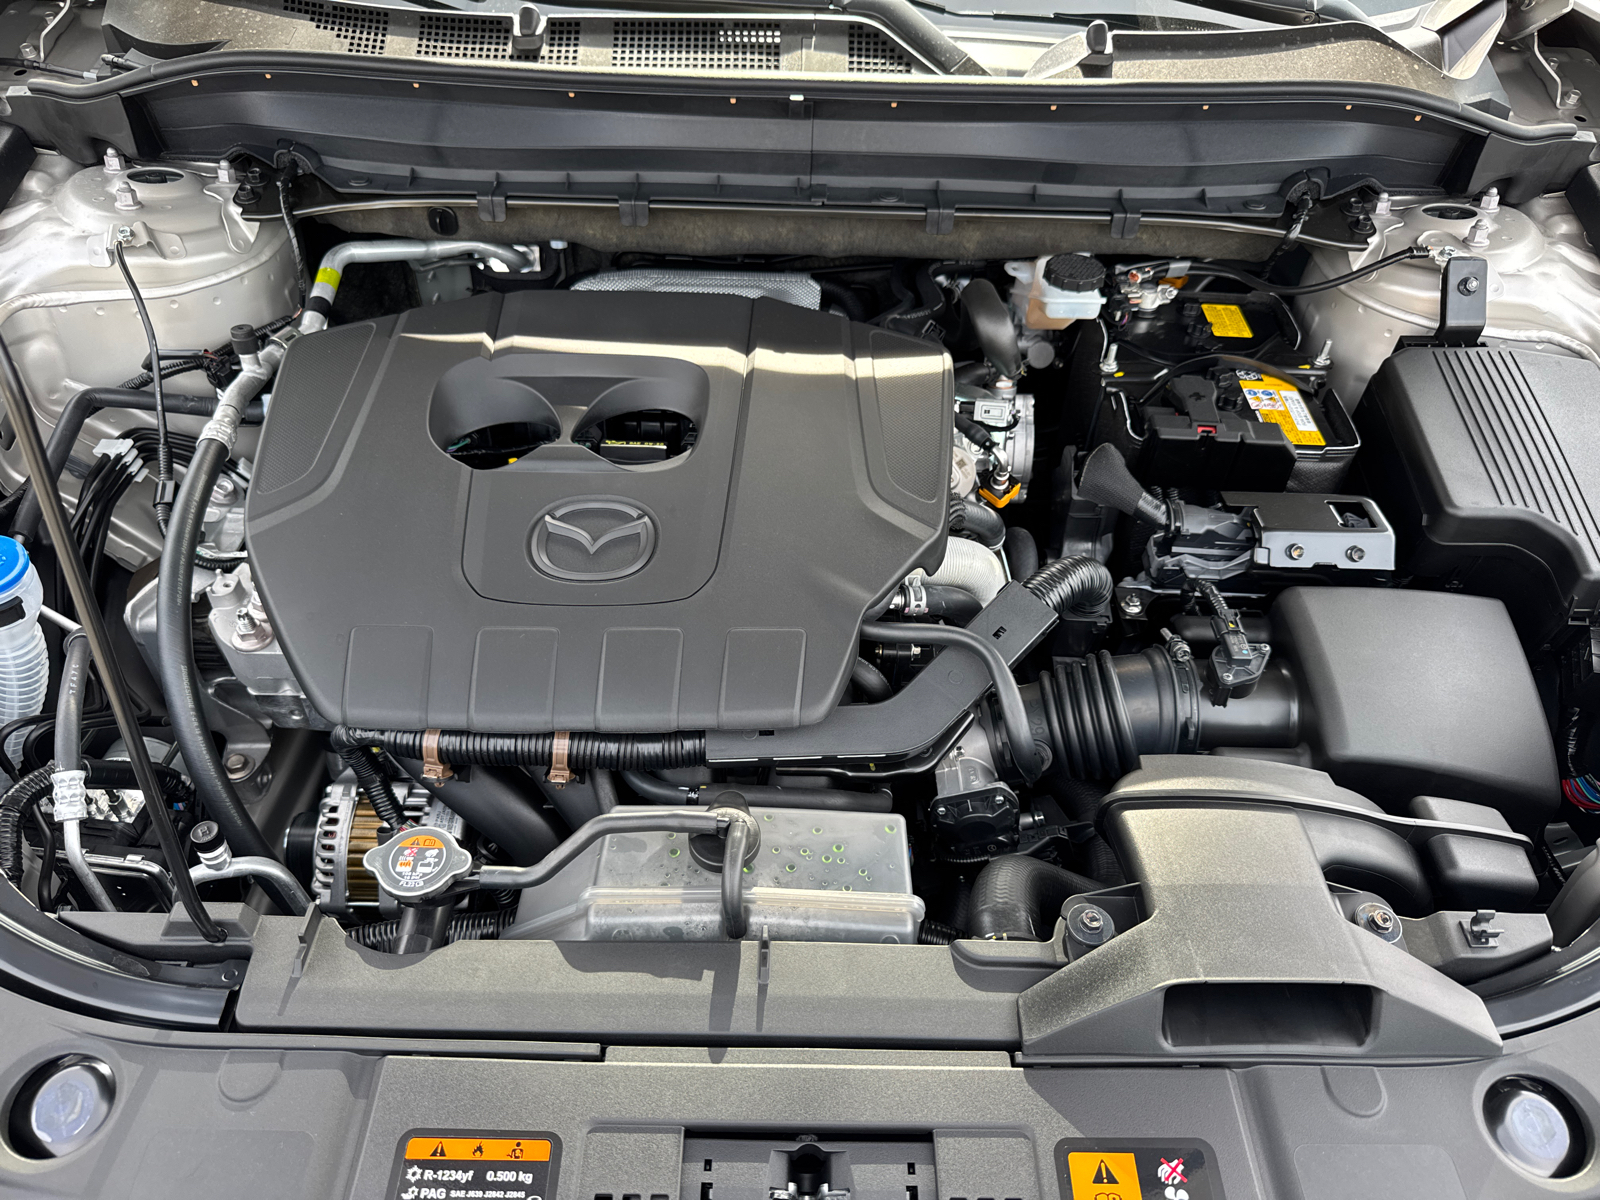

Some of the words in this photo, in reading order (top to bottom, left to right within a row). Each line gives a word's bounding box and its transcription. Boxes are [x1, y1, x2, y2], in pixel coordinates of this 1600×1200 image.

[423, 1169, 474, 1183] R-1234yf
[486, 1170, 517, 1182] 0.500
[517, 1171, 533, 1184] kg
[420, 1187, 447, 1199] PAG
[449, 1190, 466, 1198] SAE
[466, 1190, 483, 1198] J639
